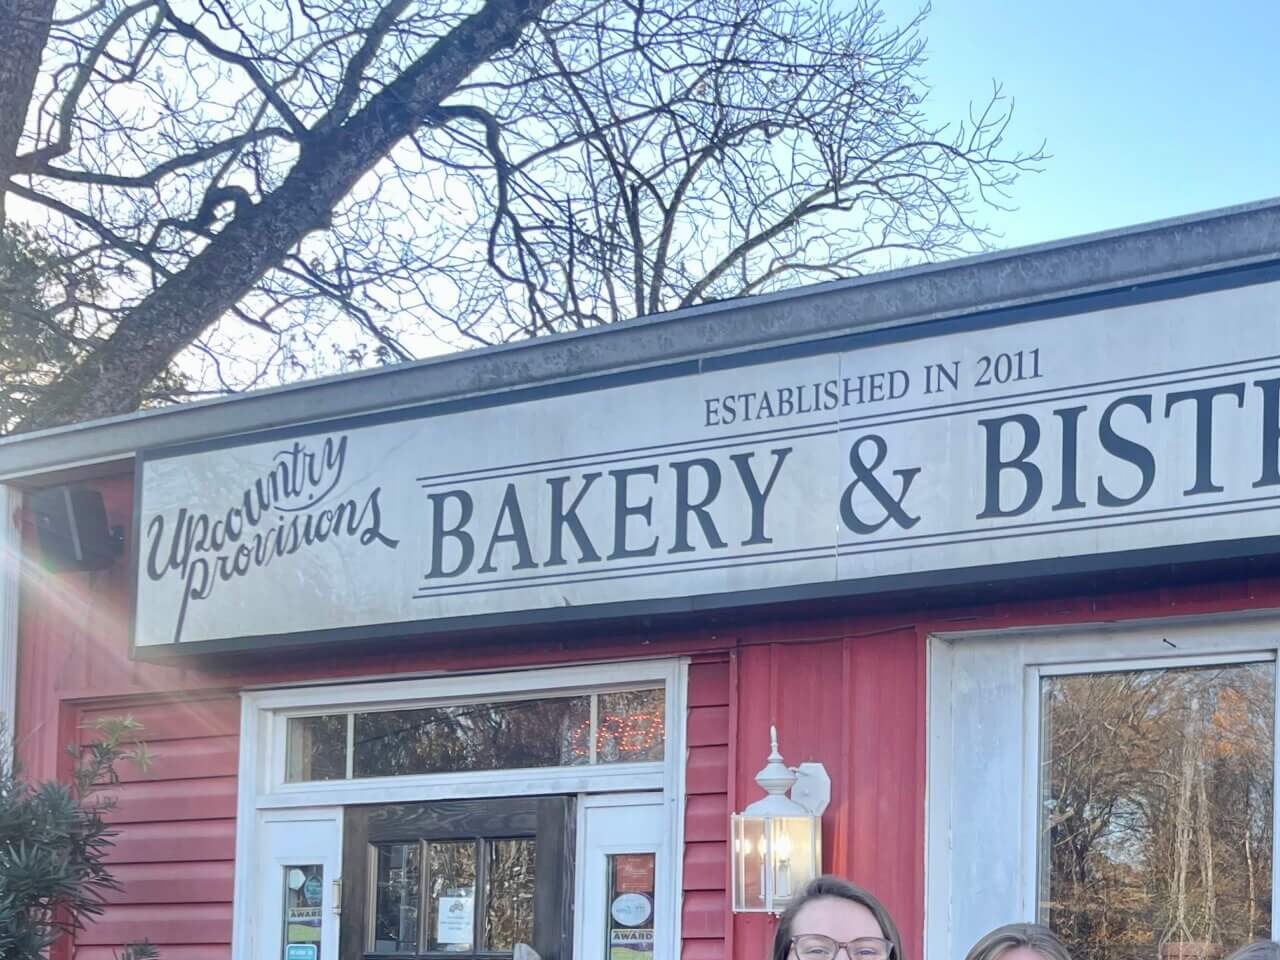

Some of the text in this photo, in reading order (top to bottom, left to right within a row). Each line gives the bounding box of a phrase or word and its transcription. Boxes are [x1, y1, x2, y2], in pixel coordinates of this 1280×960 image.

[703, 347, 1043, 428] ESTABLISHED IN 2011
[146, 435, 349, 583] Upcountry
[424, 447, 793, 580] BAKERY
[839, 434, 922, 536] &
[613, 932, 653, 941] AWARD
